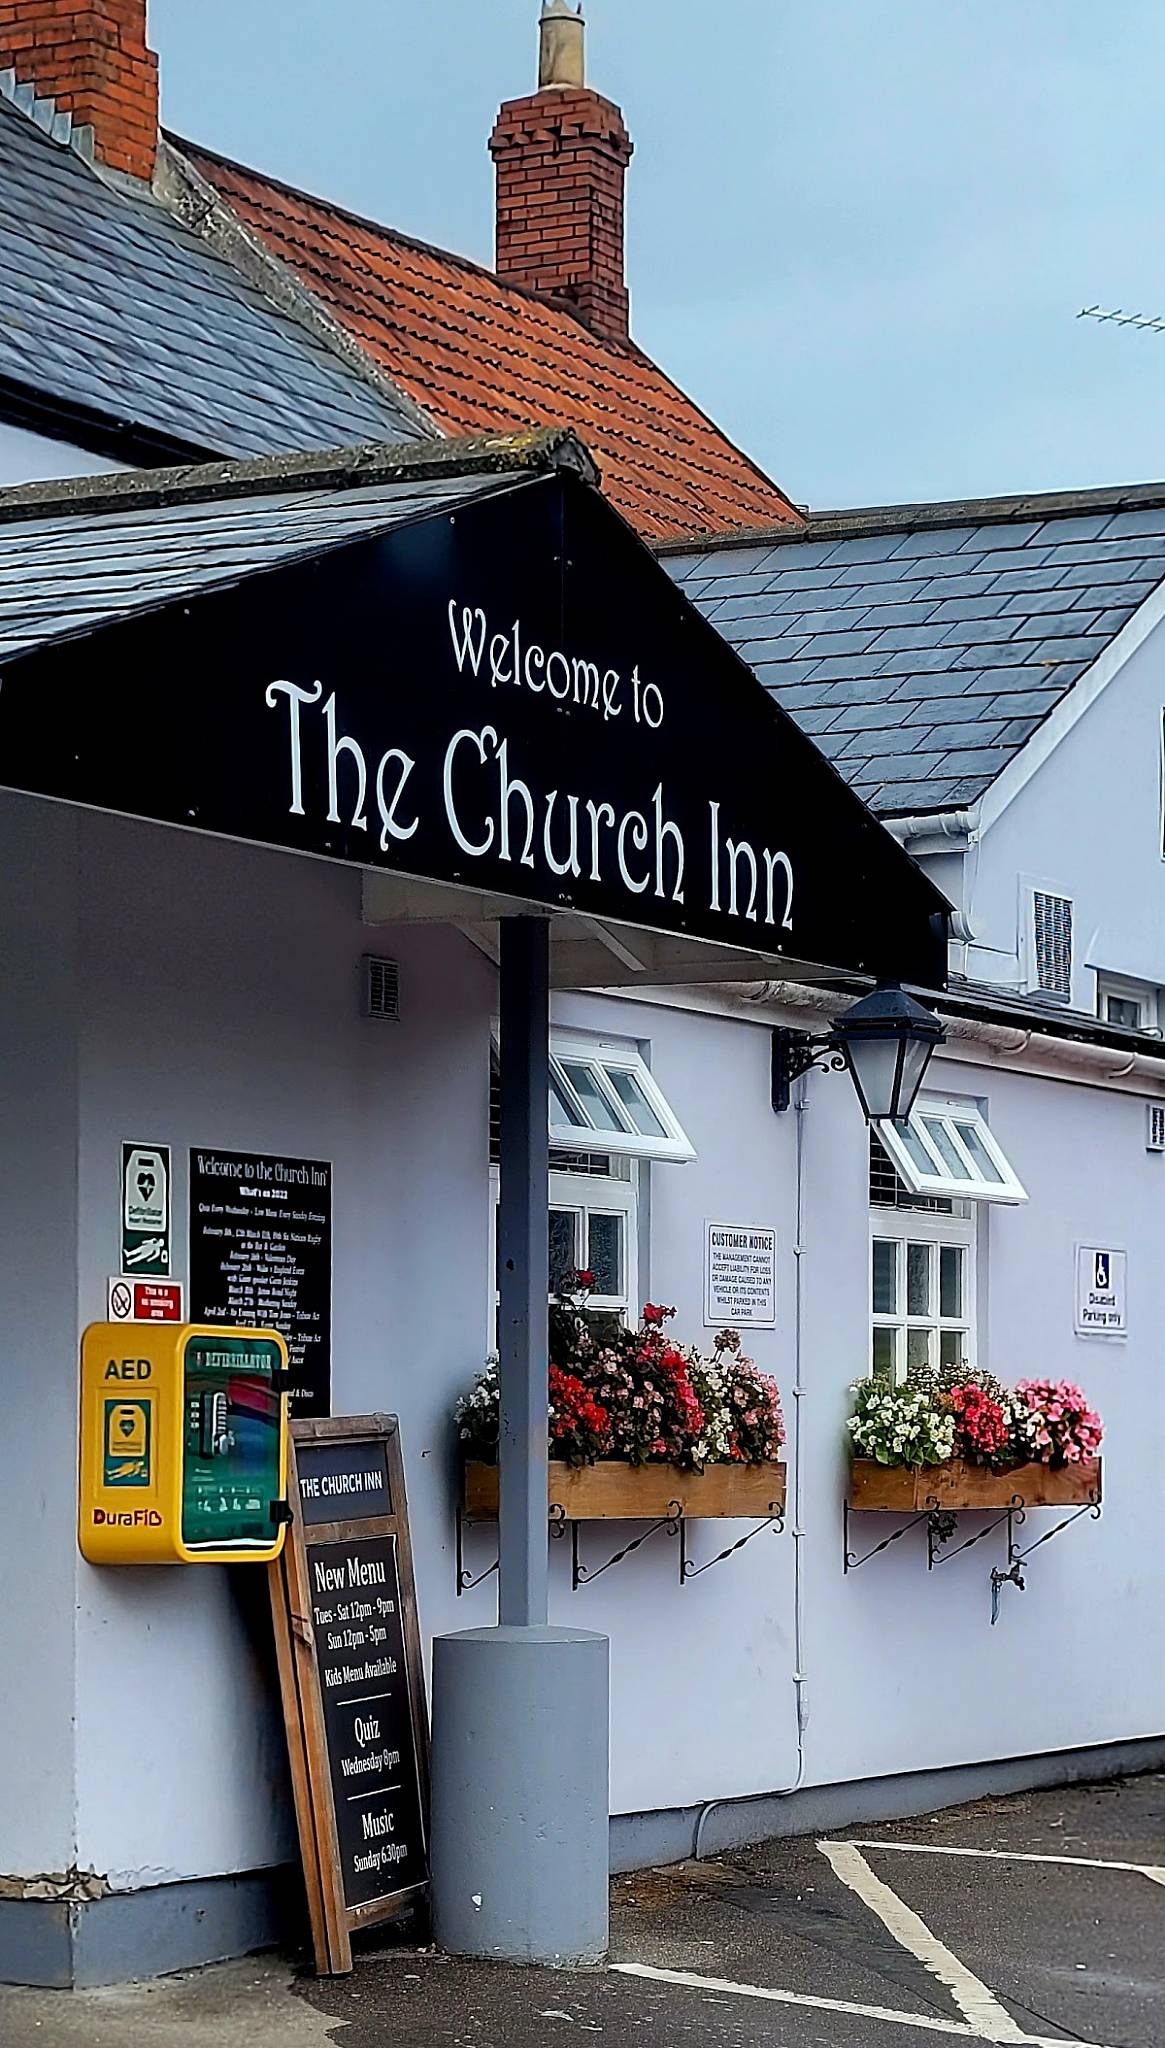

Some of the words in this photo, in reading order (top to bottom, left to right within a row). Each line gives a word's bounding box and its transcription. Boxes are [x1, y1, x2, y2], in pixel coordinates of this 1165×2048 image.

[449, 600, 622, 720] Welcome
[631, 665, 663, 727] to
[265, 680, 419, 851] The
[443, 726, 684, 904] Church
[709, 801, 794, 930] Inn
[198, 1155, 242, 1178] Welcome
[245, 1163, 254, 1178] to
[257, 1161, 272, 1180] the
[275, 1163, 308, 1184] Church
[712, 1232, 747, 1248] CUSTOMER
[749, 1236, 772, 1250] NOTICE
[713, 1252, 721, 1260] THE
[723, 1253, 752, 1262] MANAGEMENT
[730, 1265, 749, 1273] LIABILITY
[720, 1275, 737, 1283] DAMAGE
[747, 1287, 769, 1296] CONTENTS
[104, 1360, 151, 1380] AED
[300, 1477, 319, 1498] THE
[321, 1473, 362, 1496] CHURCH
[364, 1471, 383, 1491] INN
[314, 1561, 344, 1592] New
[347, 1557, 385, 1591] Menu
[314, 1607, 332, 1625] Tues
[337, 1603, 350, 1621] Sat
[351, 1602, 372, 1621] 12pm
[377, 1598, 394, 1617] 9pm
[328, 1633, 341, 1650] Sun
[343, 1630, 364, 1650] 12pm
[369, 1625, 387, 1645] 5pm
[325, 1668, 342, 1687] Kids
[344, 1662, 364, 1684] Menu
[365, 1657, 396, 1679] Available
[354, 1717, 380, 1748] Quiz
[341, 1752, 383, 1777] Wednesday
[383, 1749, 400, 1767] 8pm
[362, 1809, 394, 1840] Music
[354, 1849, 381, 1873] Sunday
[381, 1843, 407, 1864] 6.30pm
